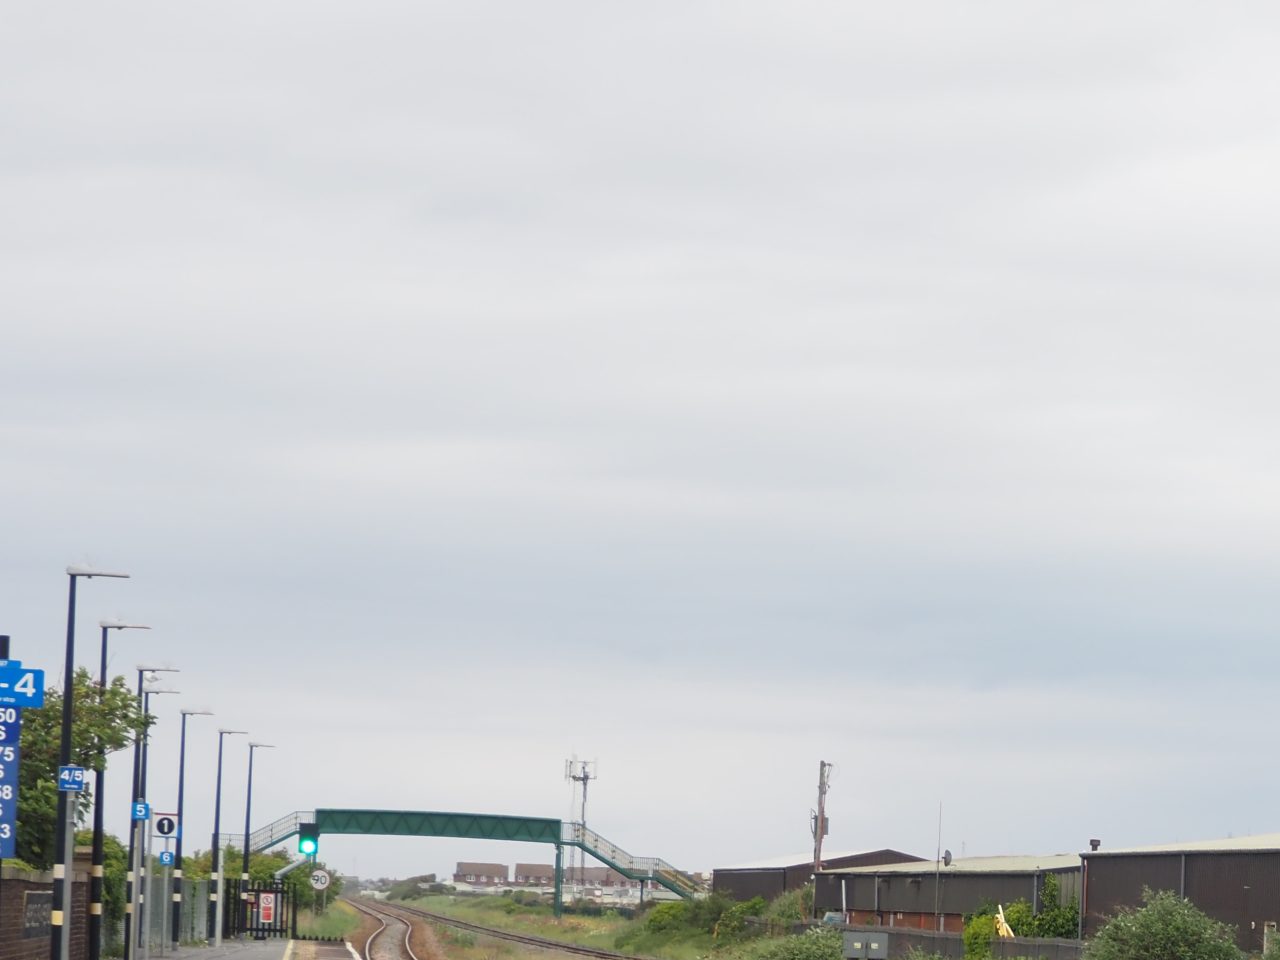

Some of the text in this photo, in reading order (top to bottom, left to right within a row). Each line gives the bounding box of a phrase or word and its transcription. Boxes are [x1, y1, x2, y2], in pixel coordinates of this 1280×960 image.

[60, 769, 83, 782] 4/5
[0, 784, 12, 800] 8
[136, 804, 146, 816] 5
[162, 819, 169, 833] 1
[162, 852, 171, 862] 6
[311, 874, 326, 885] 90
